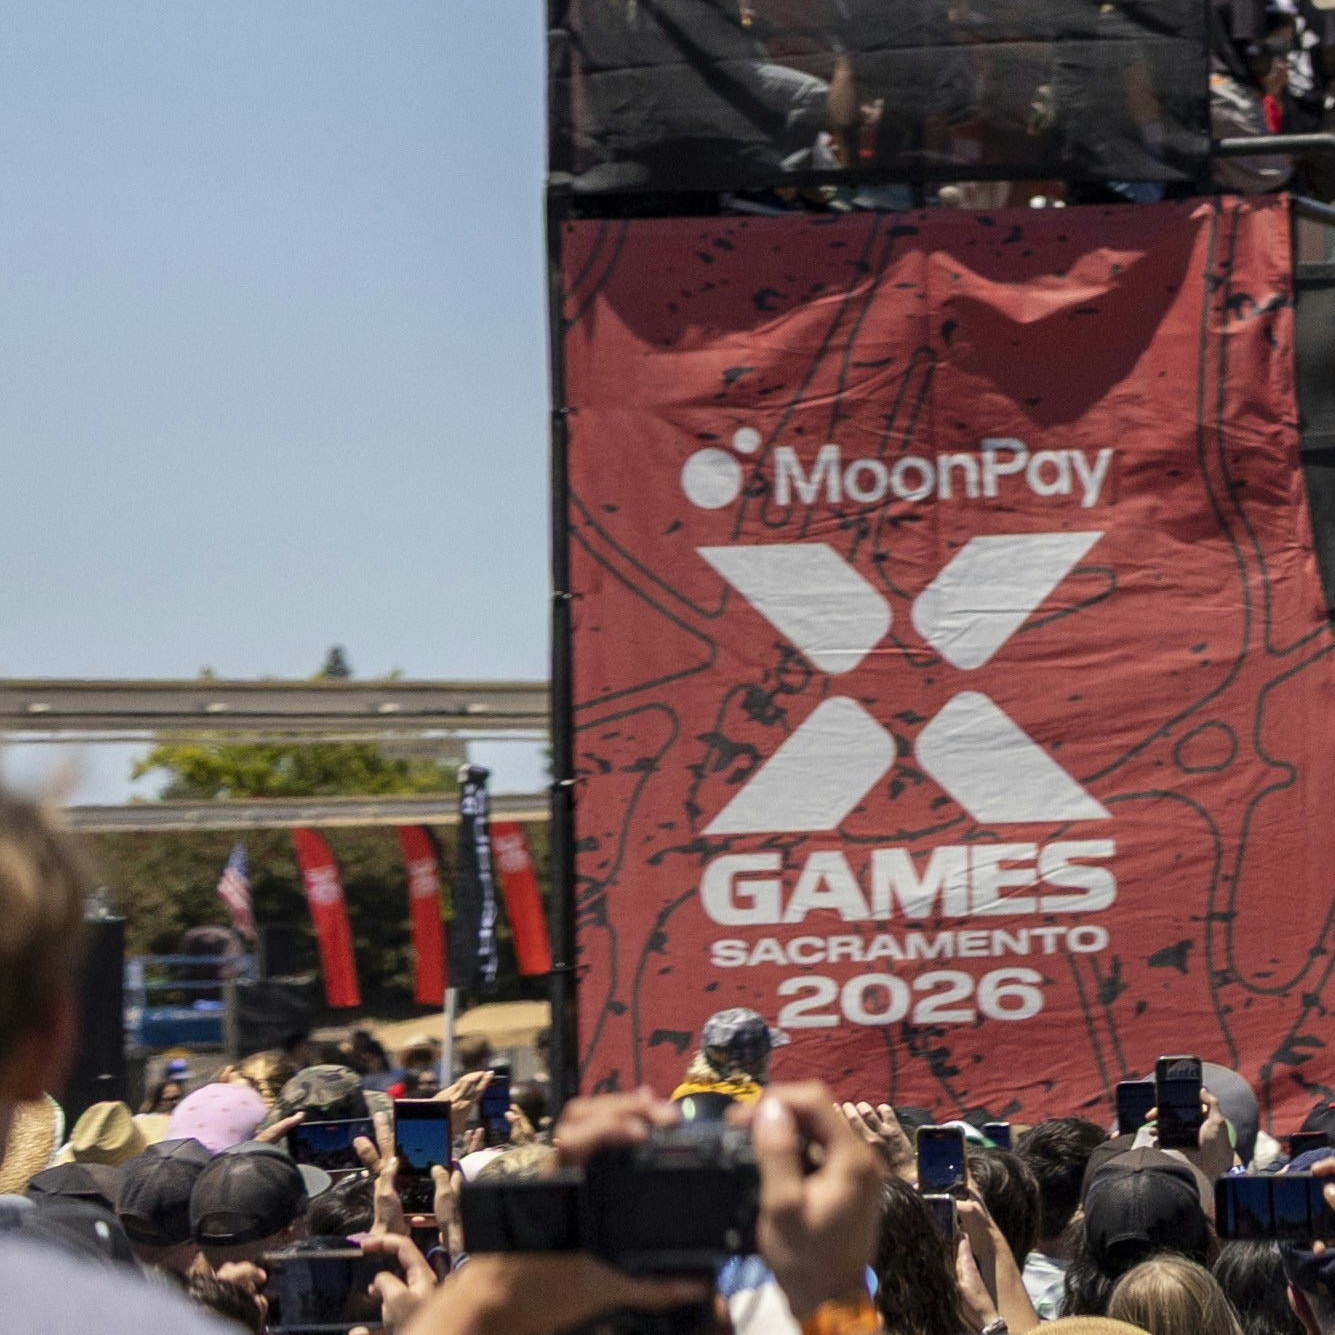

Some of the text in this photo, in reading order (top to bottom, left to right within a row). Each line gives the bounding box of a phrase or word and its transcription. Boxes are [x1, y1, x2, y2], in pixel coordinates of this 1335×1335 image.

[774, 437, 1115, 509] MoonPay
[694, 530, 1114, 836] X
[701, 839, 1118, 926] GAMES
[711, 925, 1110, 968] SACRAMENTO
[776, 967, 1045, 1029] 2026
